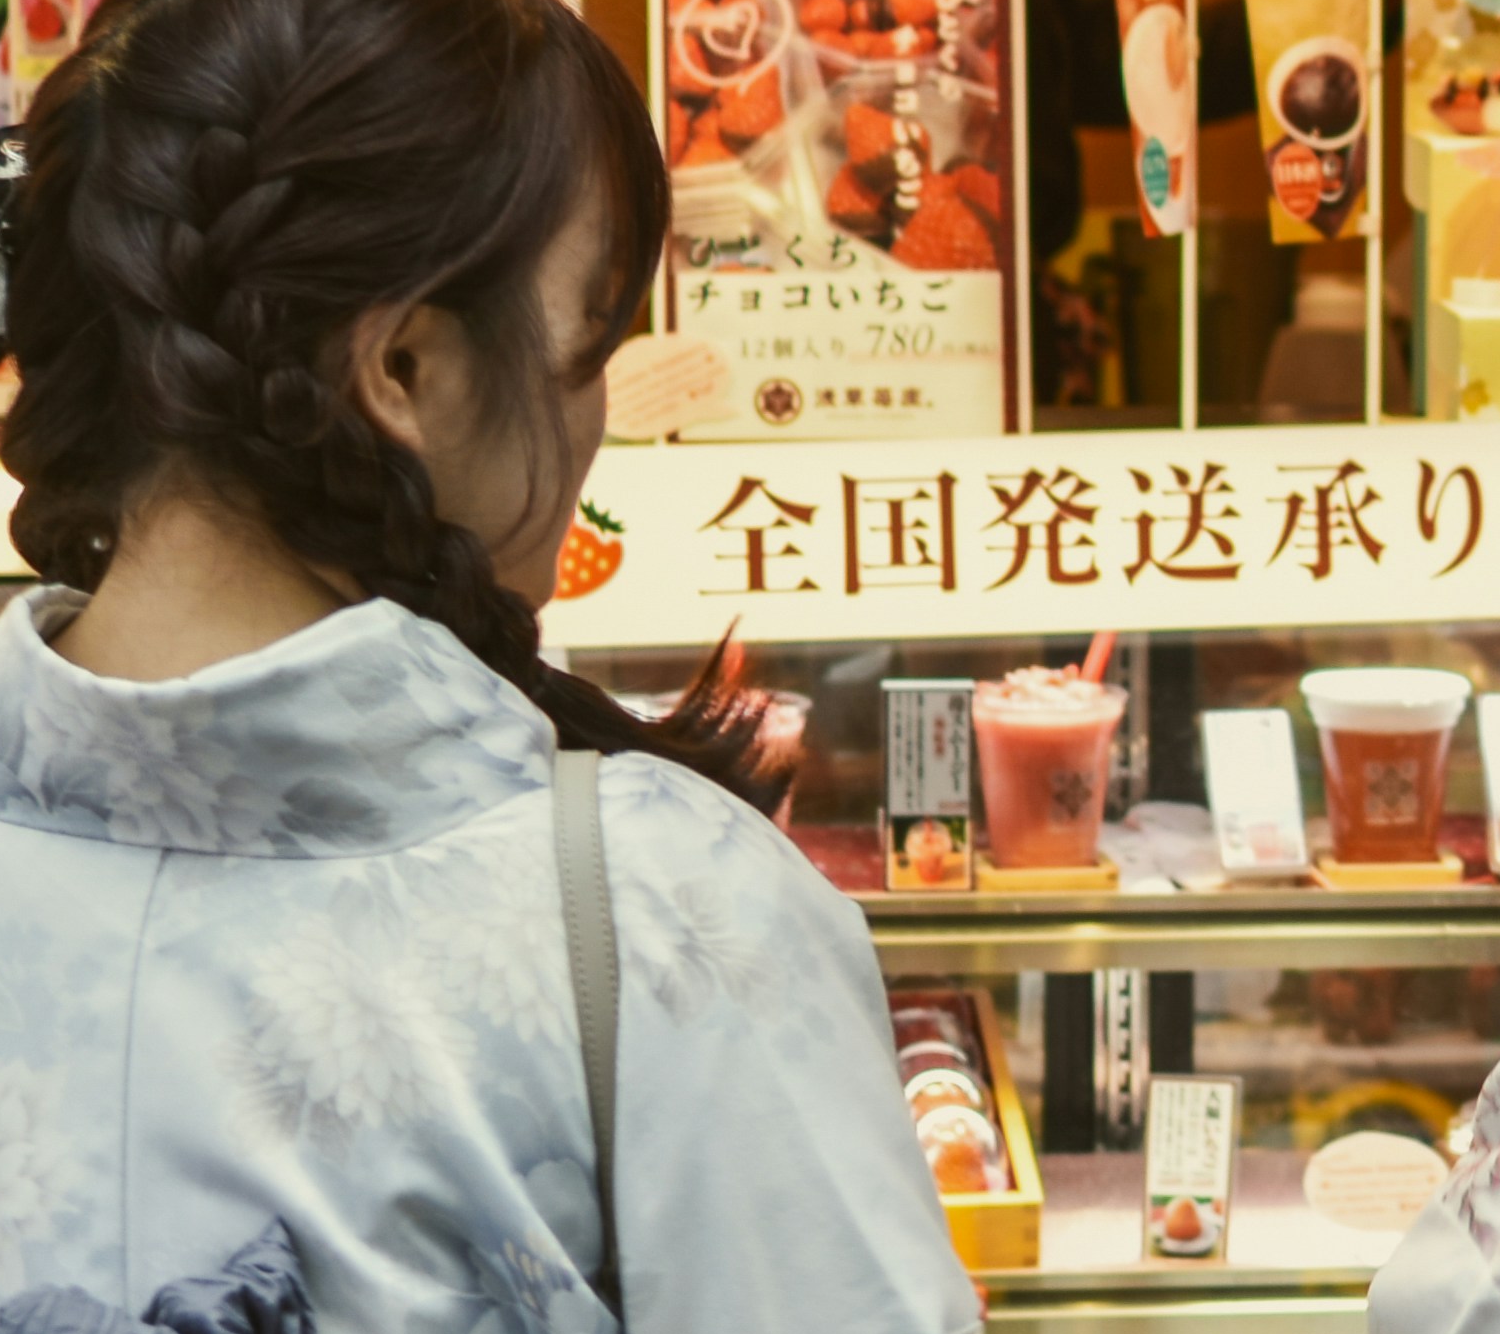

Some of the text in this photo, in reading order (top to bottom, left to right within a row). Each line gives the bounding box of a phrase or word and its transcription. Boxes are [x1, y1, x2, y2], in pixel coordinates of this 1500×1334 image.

[688, 277, 954, 313] チョコいちご
[865, 323, 936, 358] 780
